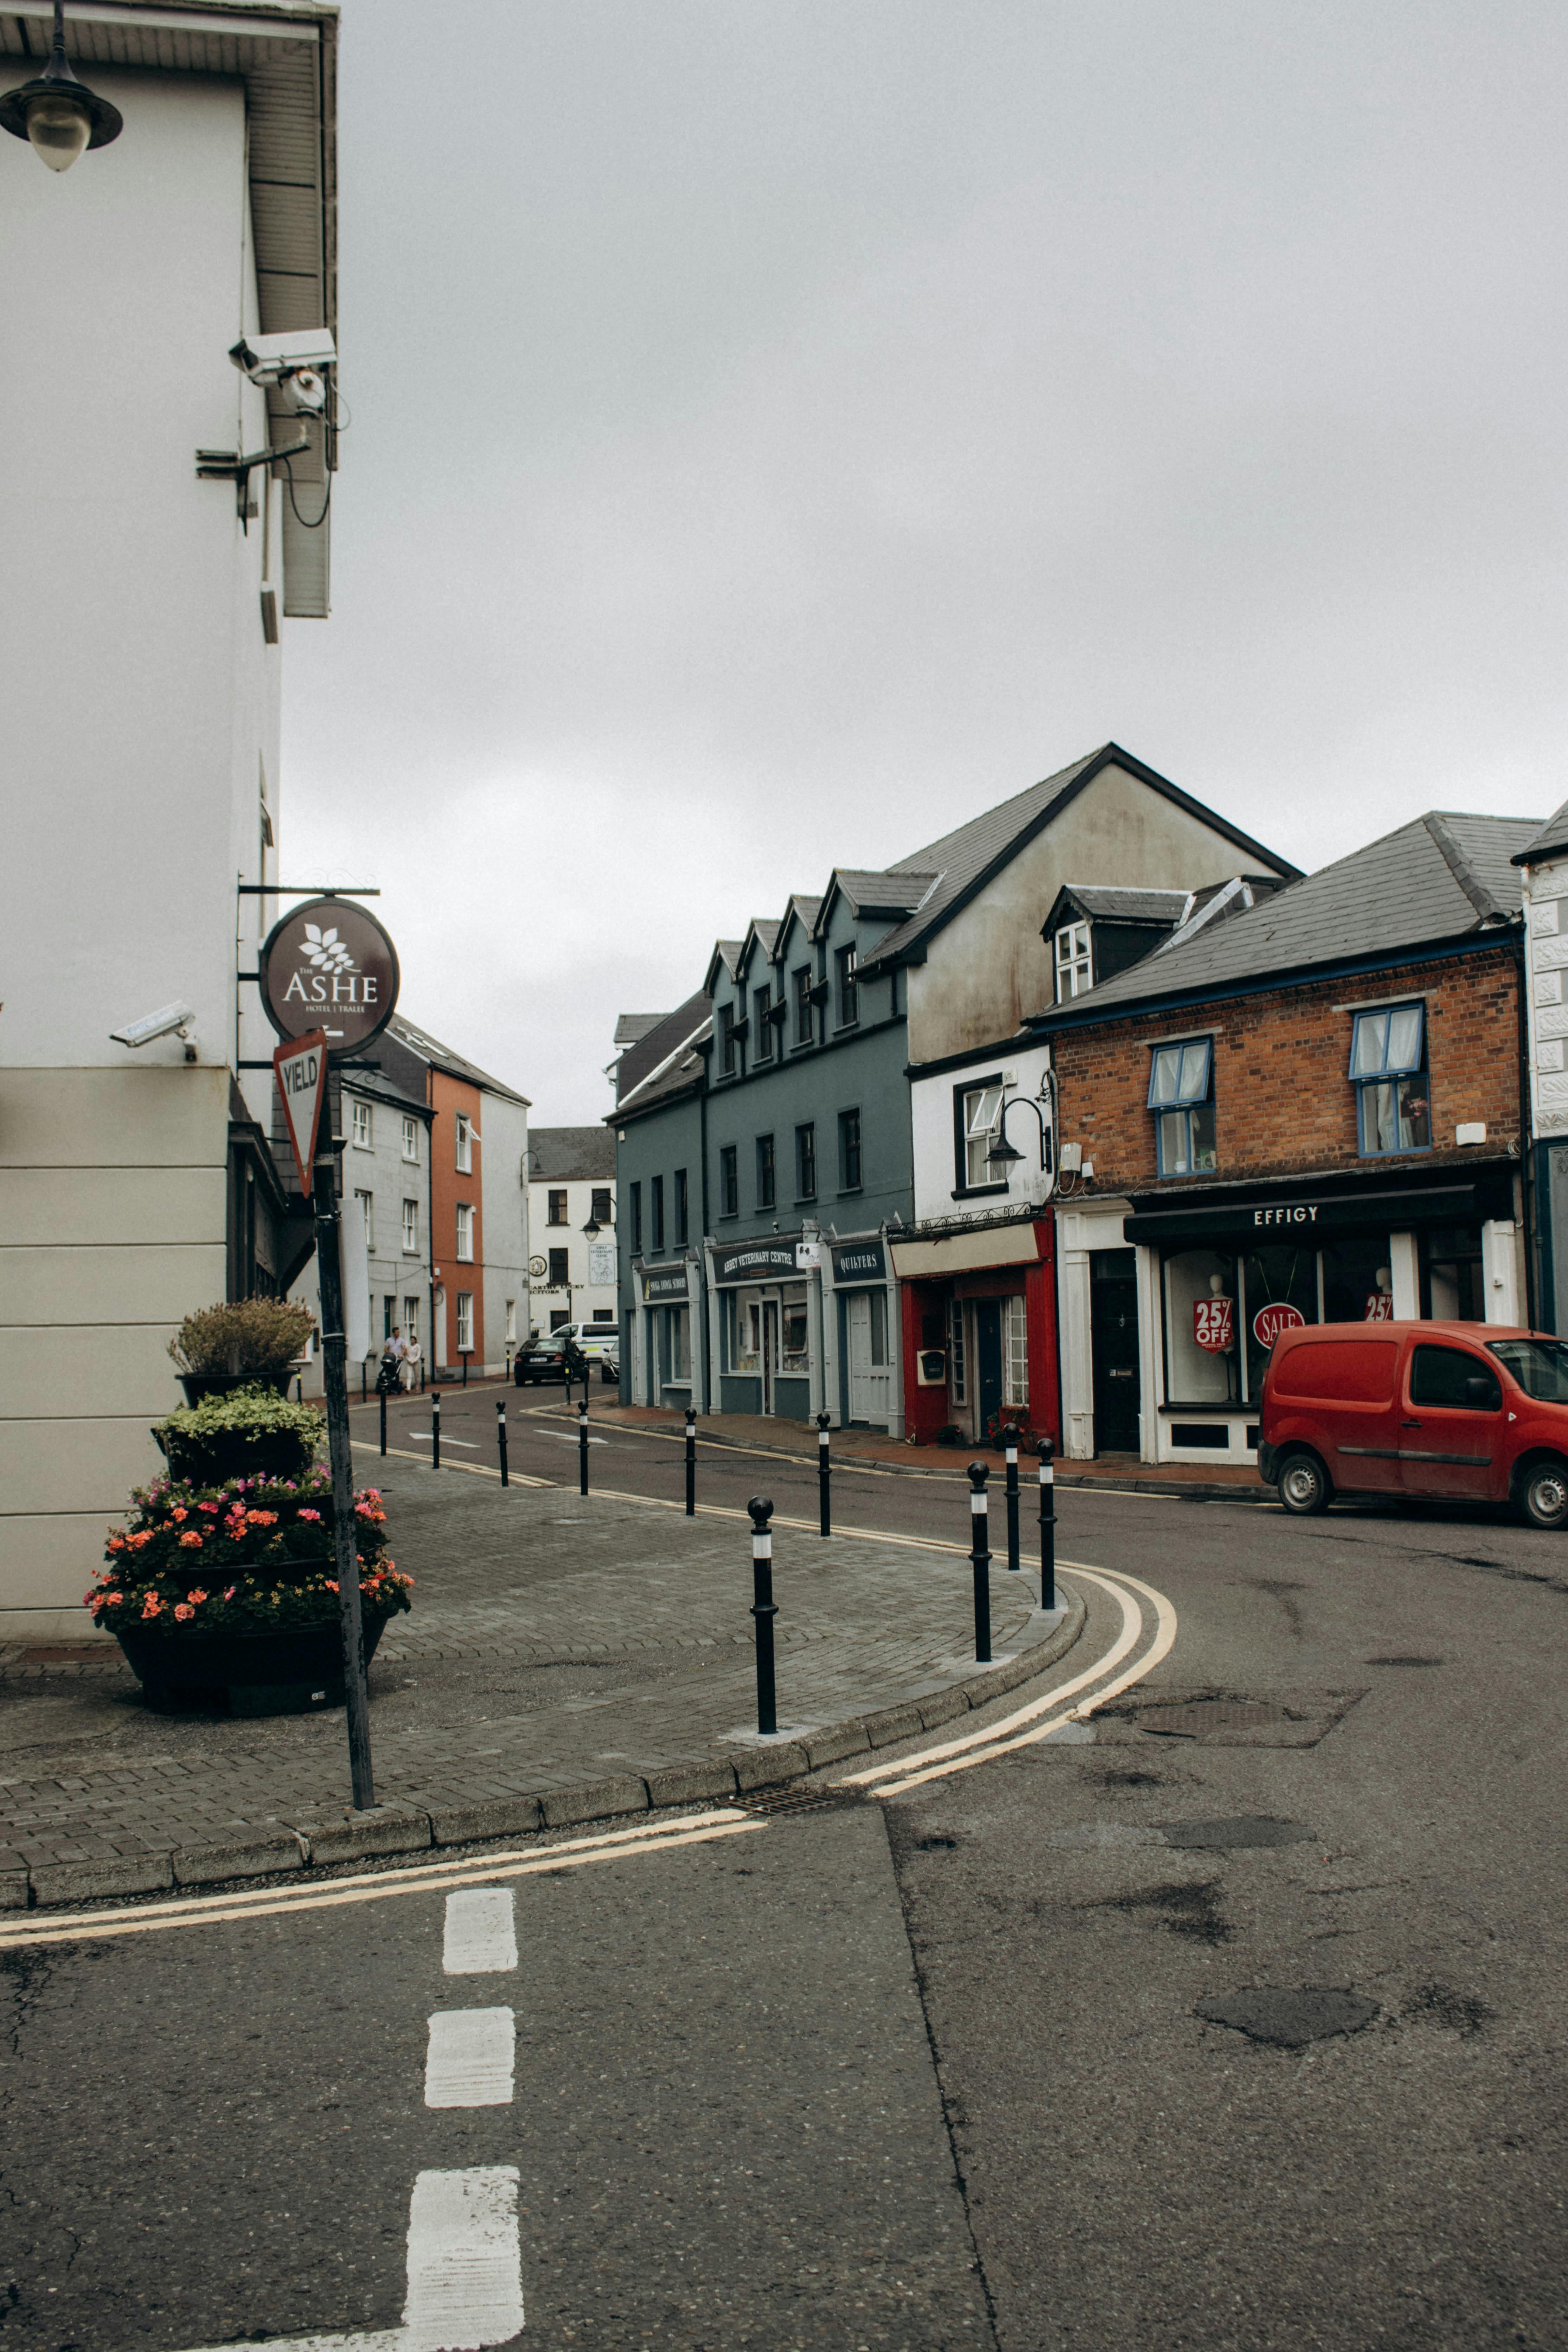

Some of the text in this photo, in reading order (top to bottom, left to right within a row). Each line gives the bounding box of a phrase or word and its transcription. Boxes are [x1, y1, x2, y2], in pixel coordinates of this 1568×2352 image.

[282, 972, 378, 1002] ASHE
[284, 1056, 317, 1095] YIELD
[1254, 1206, 1318, 1225] EFFIGY
[724, 1251, 792, 1273] ABBEY VETERINARY CENTRE
[841, 1254, 877, 1274] QUILTERS
[1197, 1300, 1231, 1329] 25%
[1367, 1296, 1393, 1321] 25%
[1197, 1329, 1229, 1343] OFF
